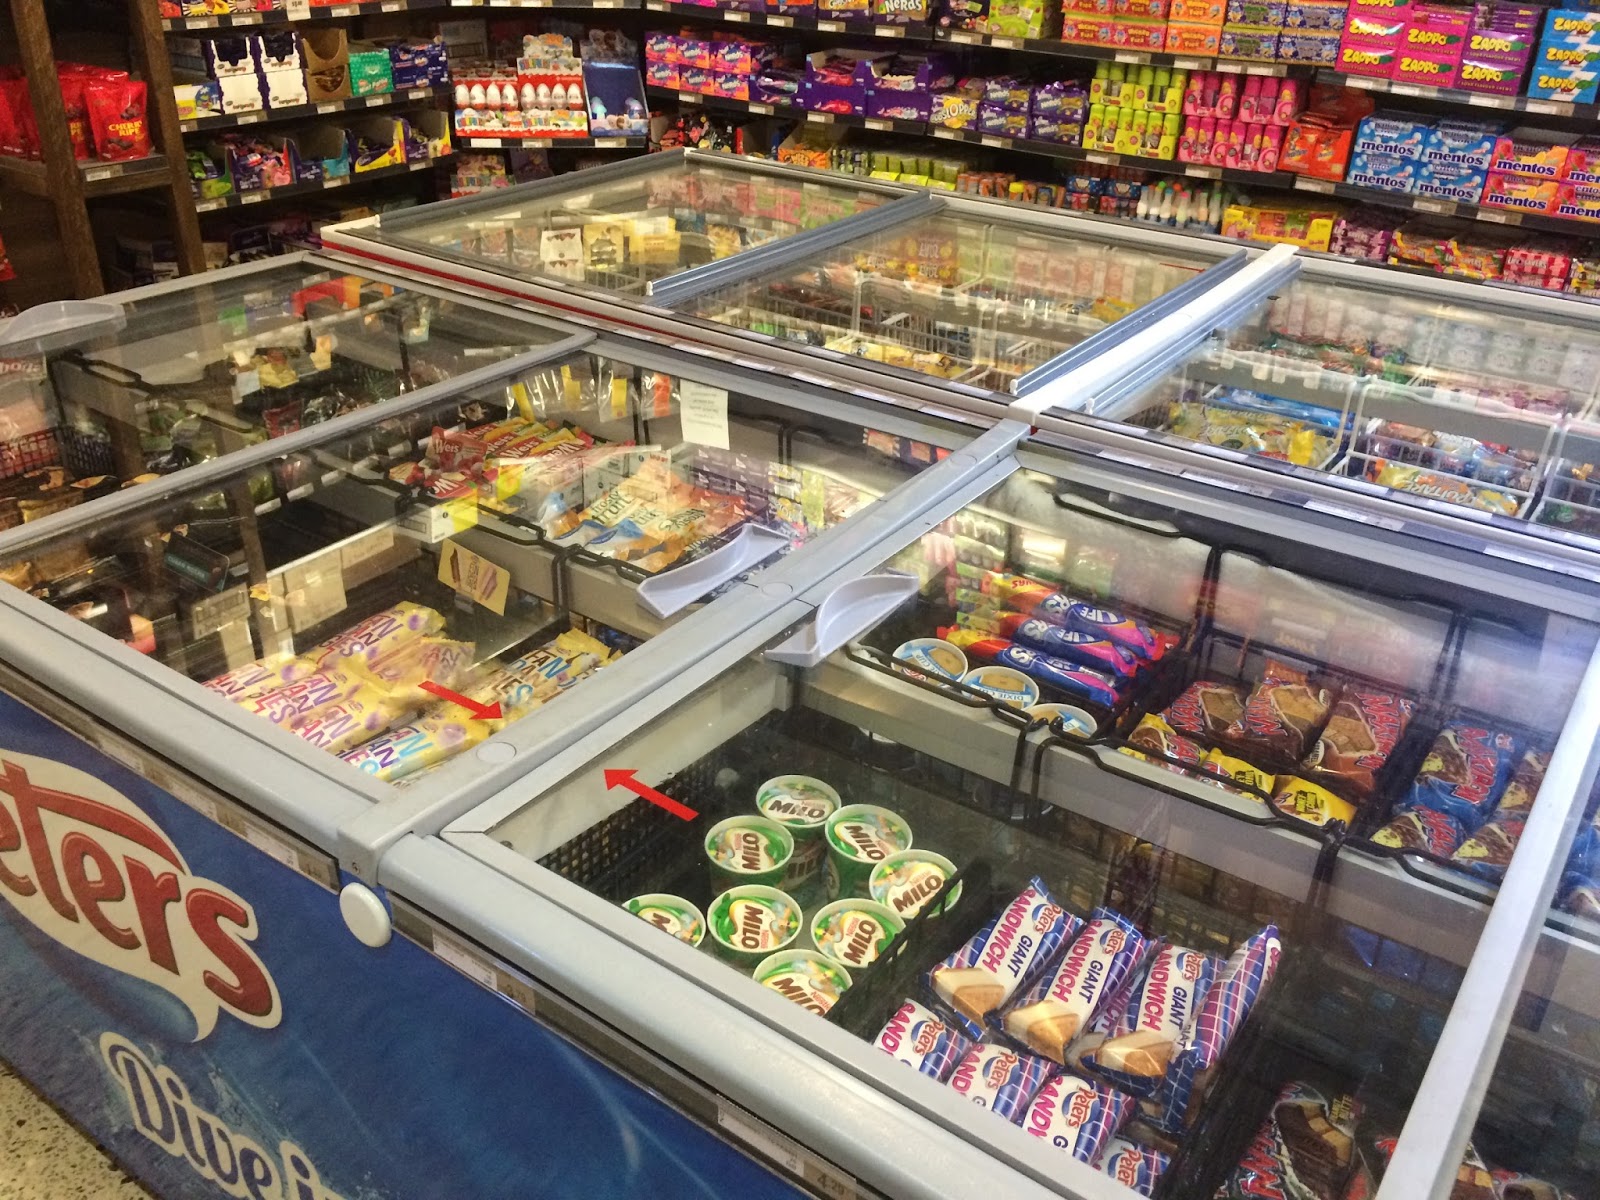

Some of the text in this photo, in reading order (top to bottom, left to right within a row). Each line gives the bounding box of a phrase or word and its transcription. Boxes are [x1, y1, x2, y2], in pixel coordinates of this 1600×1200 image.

[1554, 18, 1593, 32] ZAPPO
[1408, 29, 1447, 45] ZAPPO
[1470, 35, 1511, 52] ZAPPO
[1342, 49, 1380, 65] ZAPPO
[1400, 57, 1439, 73] ZAPPO
[1546, 47, 1585, 62] ZAPPO
[1461, 65, 1502, 82] ZAPPO
[1538, 75, 1576, 89] ZAPPO
[119, 128, 141, 137] RIPE
[1361, 140, 1415, 157] mentos
[1428, 149, 1484, 166] mentos
[1496, 159, 1556, 176] mentos
[1353, 173, 1407, 190] mentos
[1419, 182, 1475, 199] mentos
[1488, 193, 1547, 209] mentos
[435, 438, 460, 454] Weis
[500, 440, 540, 458] Weis
[1079, 606, 1118, 623] LIFE
[1057, 629, 1095, 643] LIFE
[525, 647, 571, 679] FAN
[1000, 692, 1024, 701] DIXIE
[1450, 726, 1498, 807] MAXIBON
[768, 799, 826, 819] MILO
[742, 832, 760, 870] MILO
[844, 825, 886, 861] MILO
[0, 758, 273, 1017] eters
[892, 874, 943, 913] MILO
[741, 904, 764, 949] MILO
[1034, 901, 1062, 935] Peters
[843, 920, 876, 965] MILO
[982, 888, 1037, 974] SANDWICH
[1104, 928, 1124, 955] eters
[1006, 935, 1033, 979] GIANT
[1078, 959, 1104, 1005] GIANT
[772, 977, 826, 1017] MILO
[1168, 986, 1188, 1030] GIANT
[881, 1002, 916, 1056] SAND
[914, 1018, 945, 1056] Peters
[951, 1043, 985, 1097] SAND
[986, 1050, 1018, 1090] Peters
[1068, 1085, 1097, 1129] Peters
[1117, 1146, 1143, 1187] Peter
